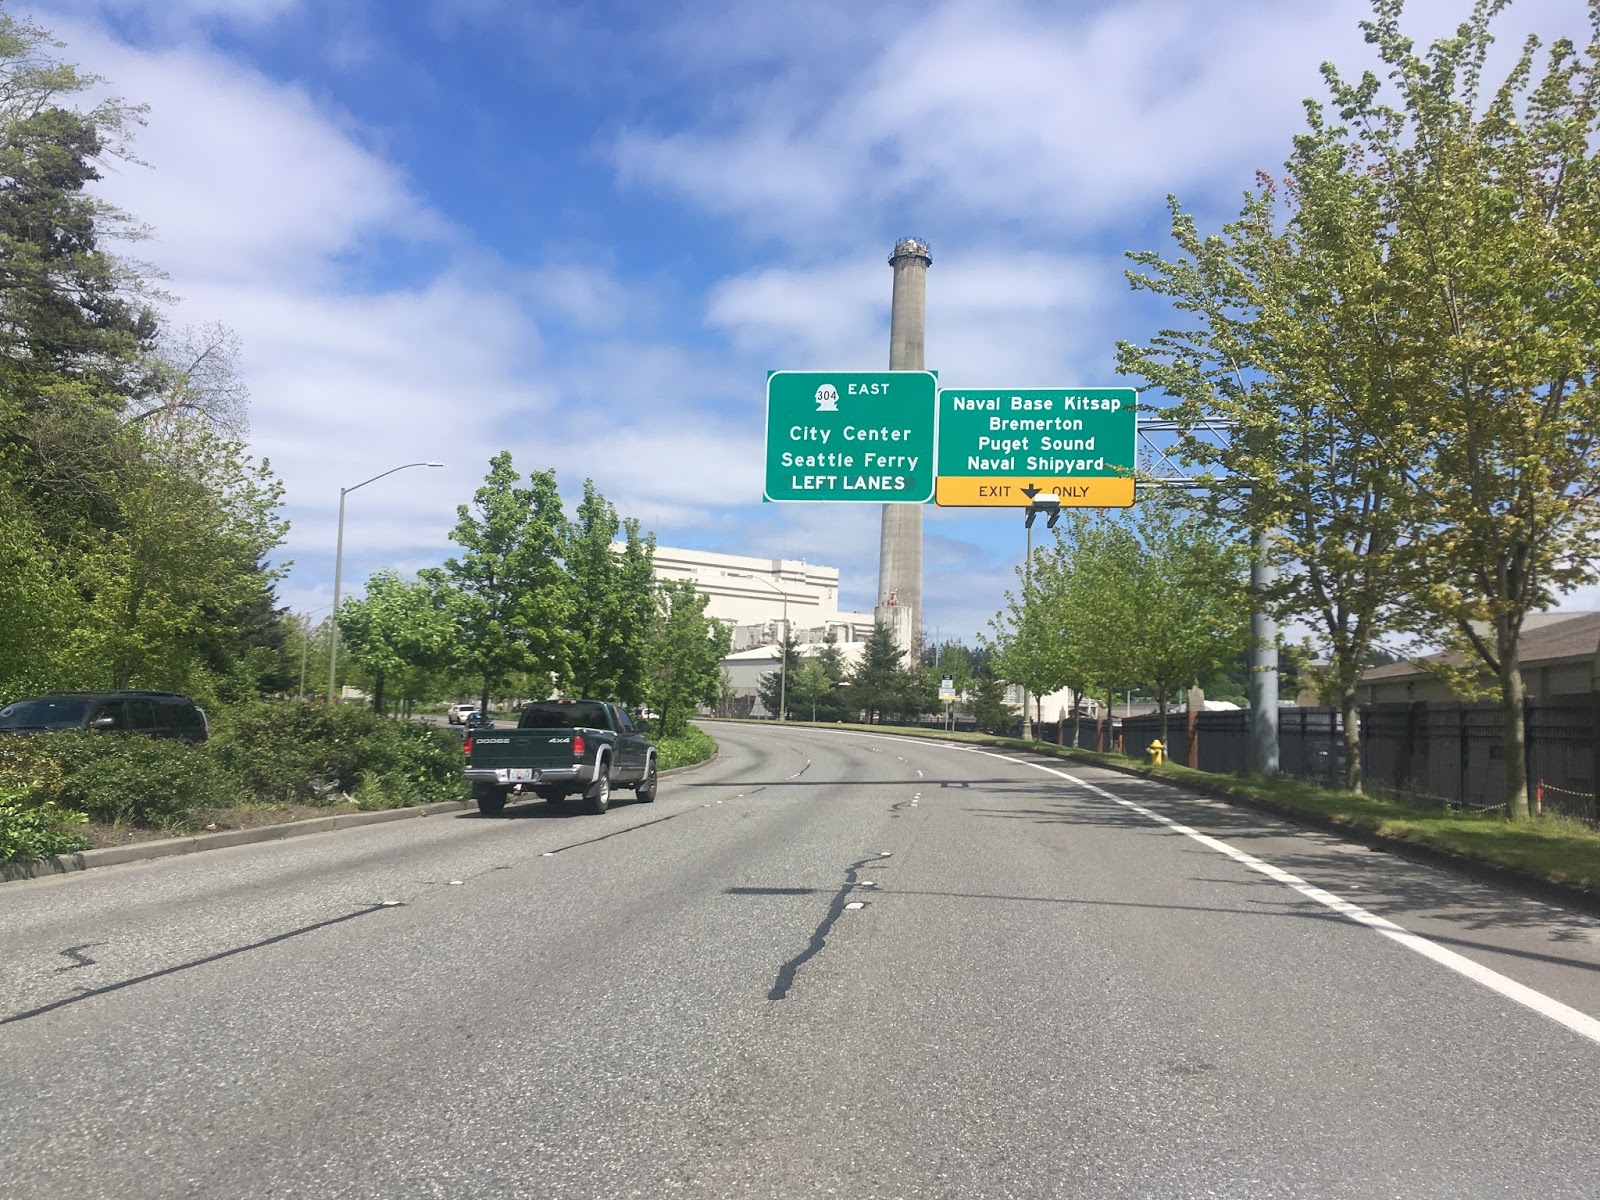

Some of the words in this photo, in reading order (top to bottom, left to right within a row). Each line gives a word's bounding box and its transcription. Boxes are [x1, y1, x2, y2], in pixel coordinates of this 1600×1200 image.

[817, 390, 837, 401] 304
[848, 383, 890, 395] EAST
[953, 396, 1000, 411] Naval
[1011, 396, 1053, 411] Base
[1064, 396, 1121, 413] Kitsap
[989, 416, 1083, 431] Bremerton
[790, 425, 831, 444] City
[843, 425, 911, 441] Center
[978, 436, 1029, 455] Puget
[1040, 436, 1095, 451] Sound
[781, 452, 854, 468] Seattle
[864, 452, 919, 471] Ferry
[967, 456, 1015, 471] Naval
[1026, 456, 1104, 474] Shipyard
[792, 475, 837, 490] LEFT
[843, 475, 905, 490] LANES
[979, 486, 1011, 497] EXIT
[1052, 486, 1090, 497] ONLY
